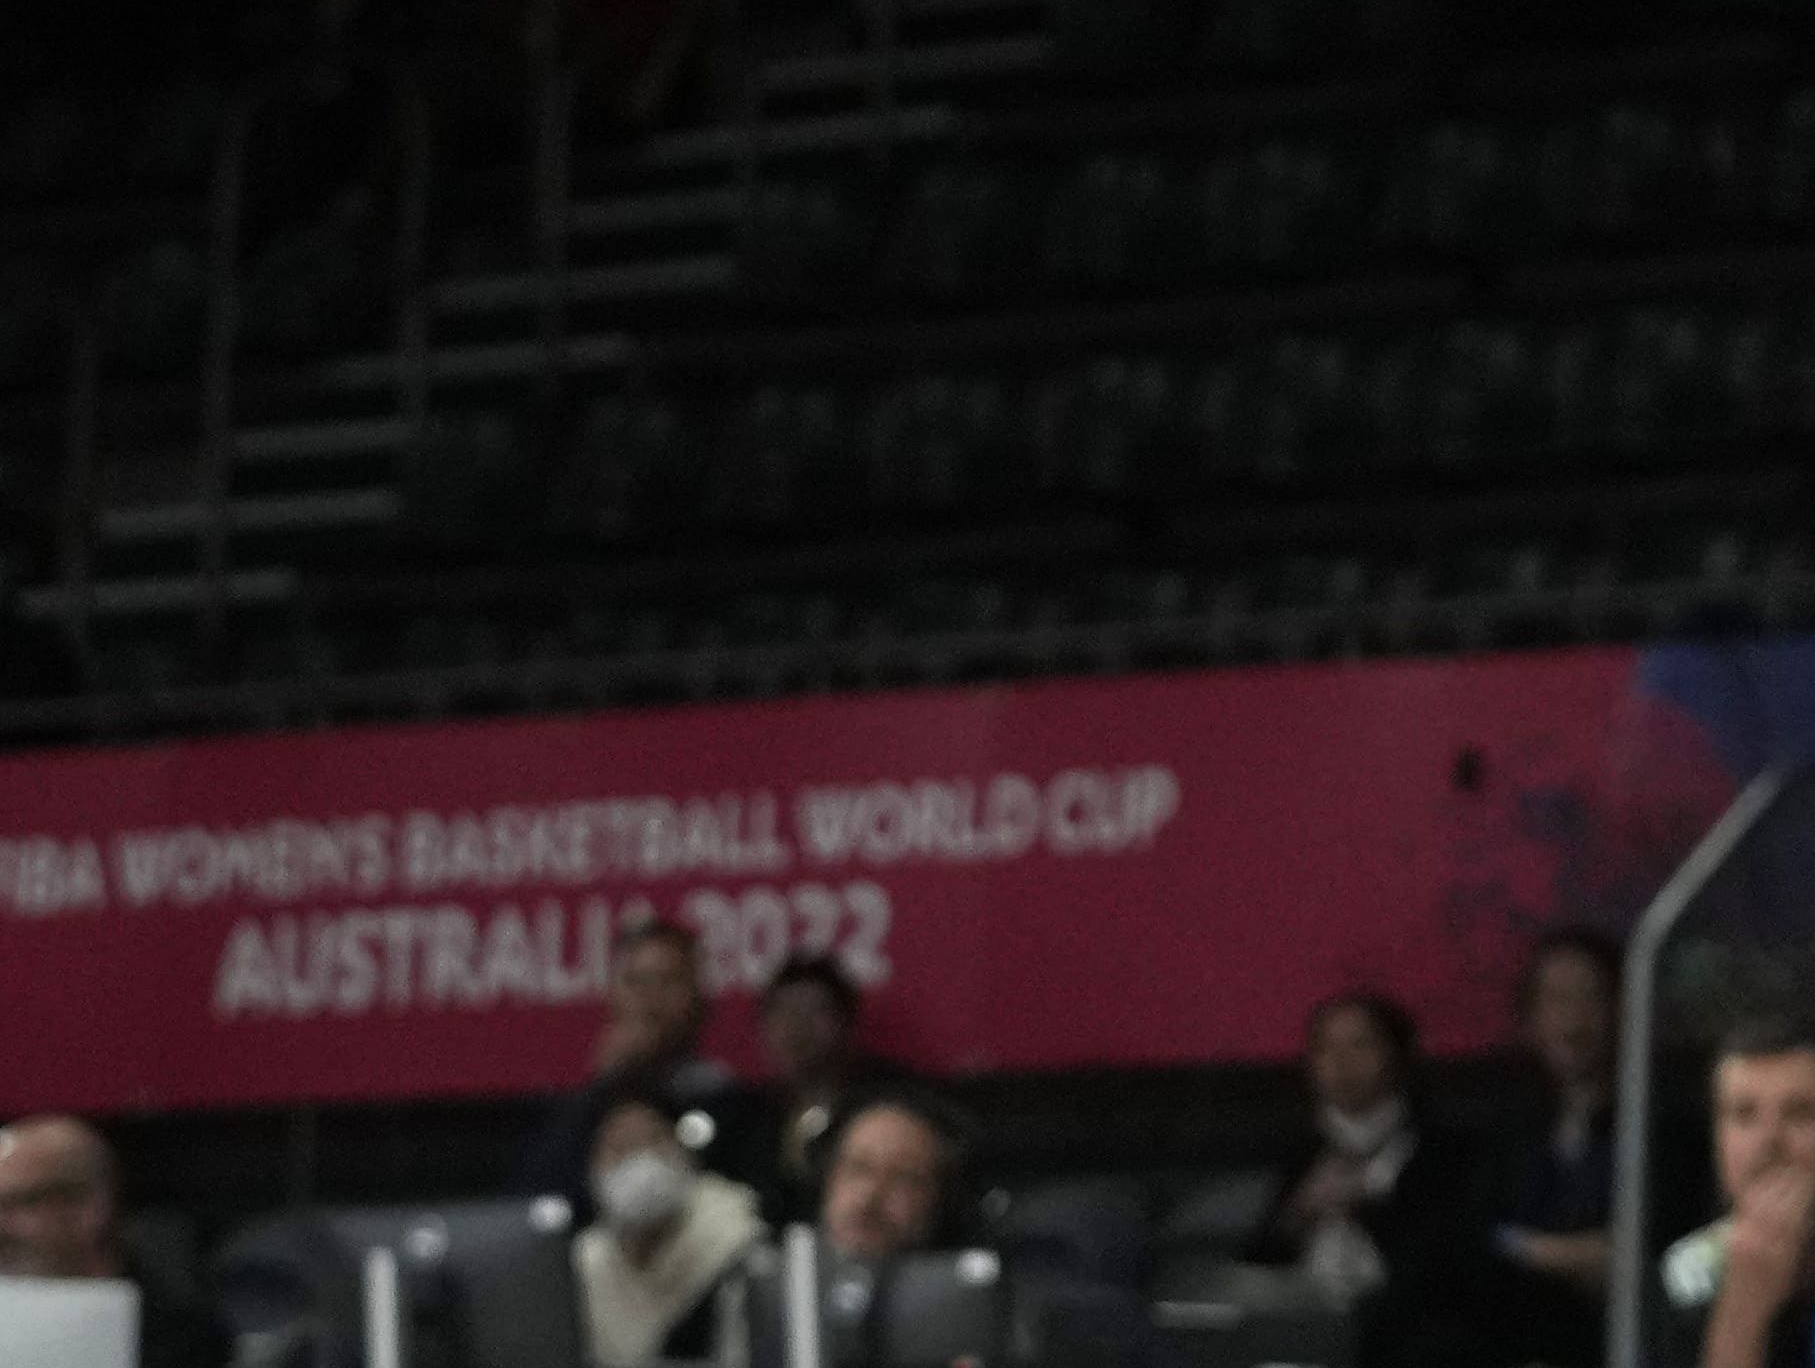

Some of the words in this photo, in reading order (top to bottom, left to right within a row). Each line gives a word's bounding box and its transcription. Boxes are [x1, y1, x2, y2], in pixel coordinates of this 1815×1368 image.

[119, 815, 390, 911] WOMEN'S
[405, 789, 792, 890] BASKETBALL
[798, 771, 1042, 867] WORLD
[1046, 765, 1180, 855] CUP
[216, 895, 655, 1017] AUSTRALI
